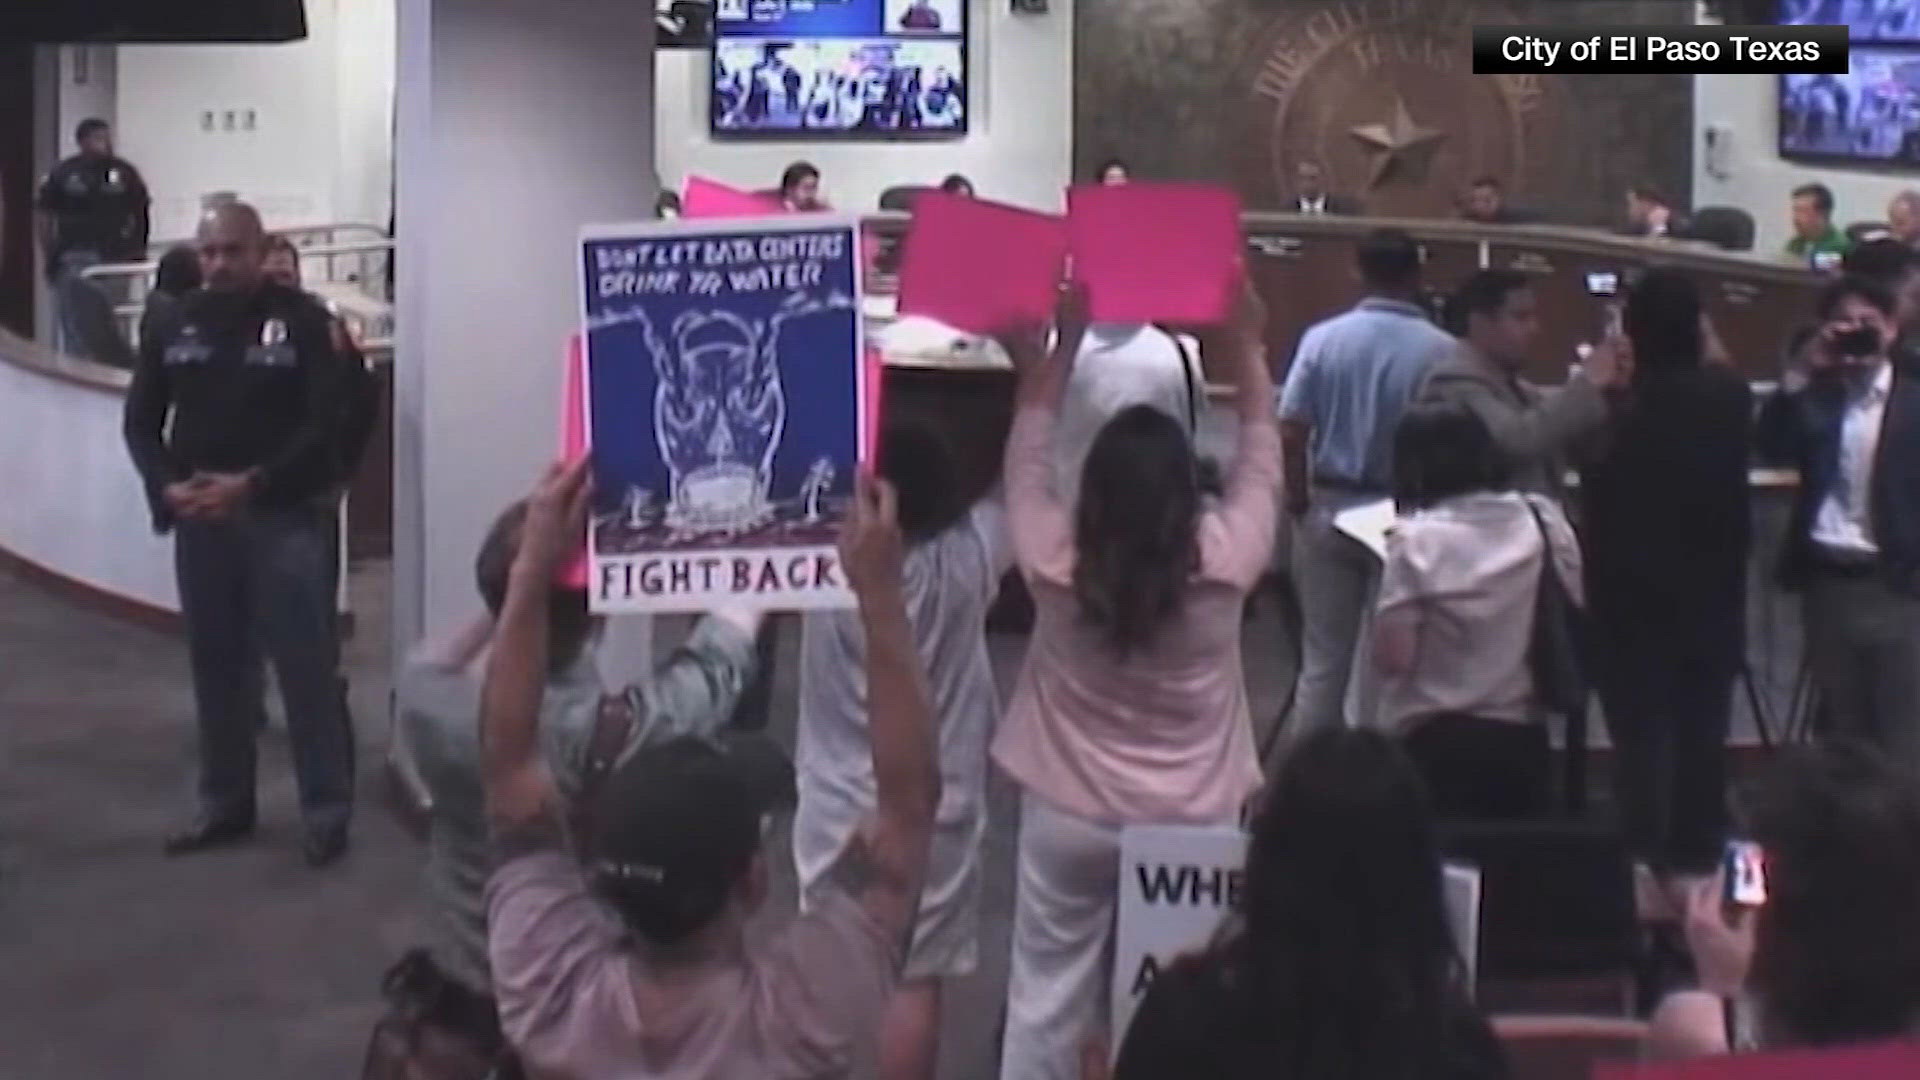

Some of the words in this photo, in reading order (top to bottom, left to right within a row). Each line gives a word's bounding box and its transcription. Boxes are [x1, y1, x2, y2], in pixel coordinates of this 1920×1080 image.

[600, 271, 680, 297] DRINK
[728, 263, 822, 291] WATER
[600, 559, 721, 599] FIGHT
[731, 555, 837, 592] BACK
